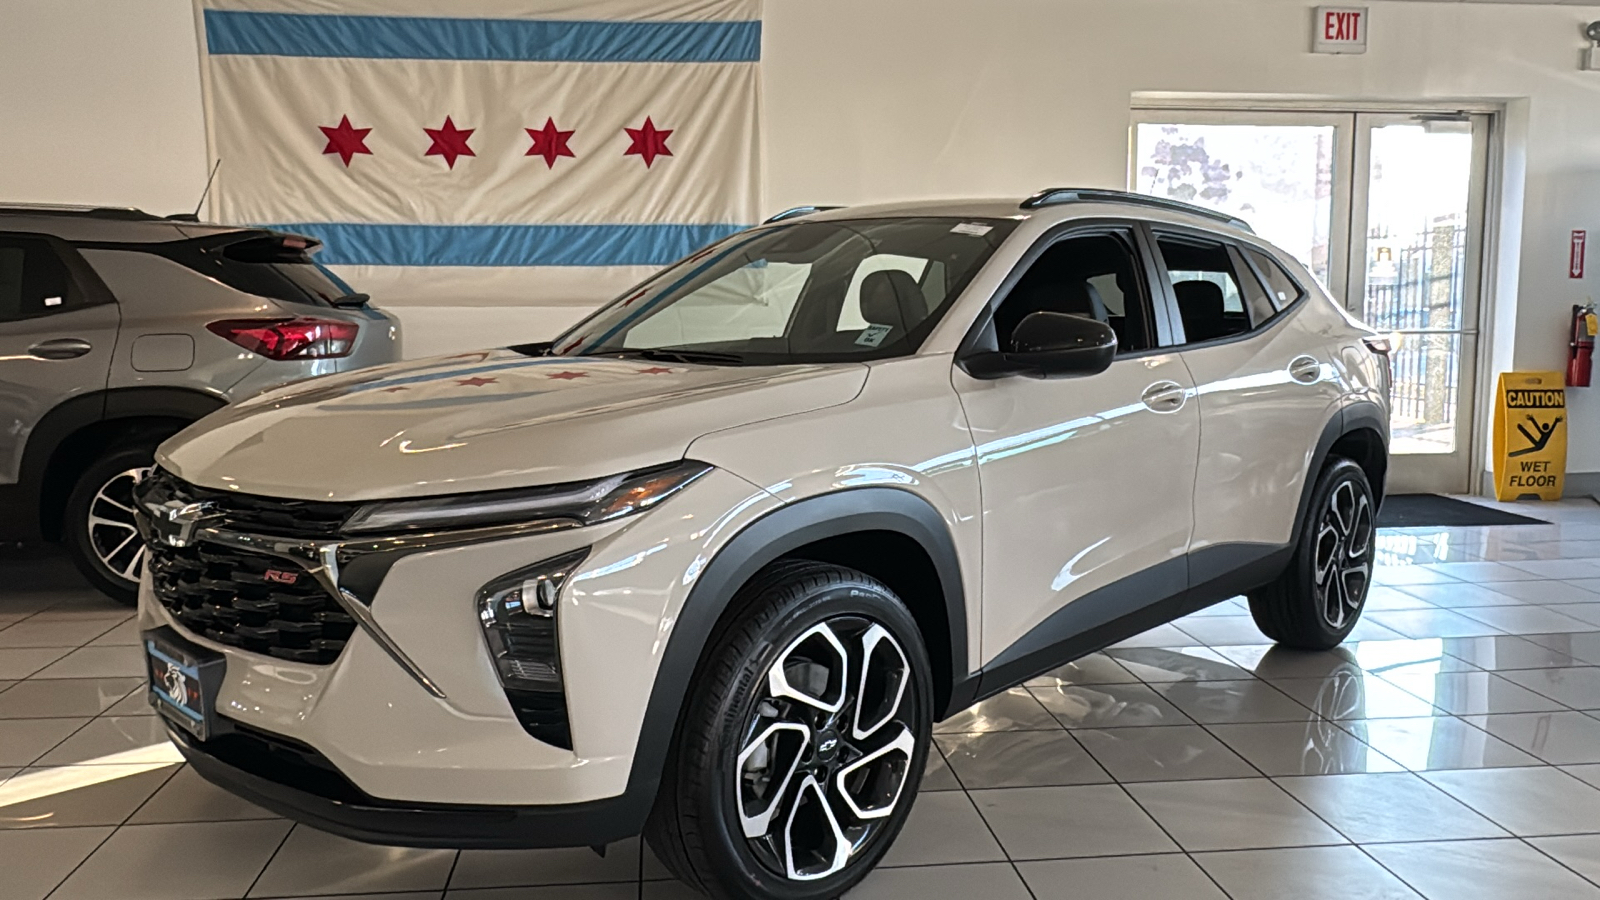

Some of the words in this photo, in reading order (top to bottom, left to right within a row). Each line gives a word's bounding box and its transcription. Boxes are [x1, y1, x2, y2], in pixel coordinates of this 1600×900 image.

[1325, 12, 1360, 40] EXIT
[1507, 391, 1564, 406] CAUTION
[1520, 461, 1551, 472] WET
[1509, 475, 1556, 487] FLOOR
[263, 569, 299, 585] RS
